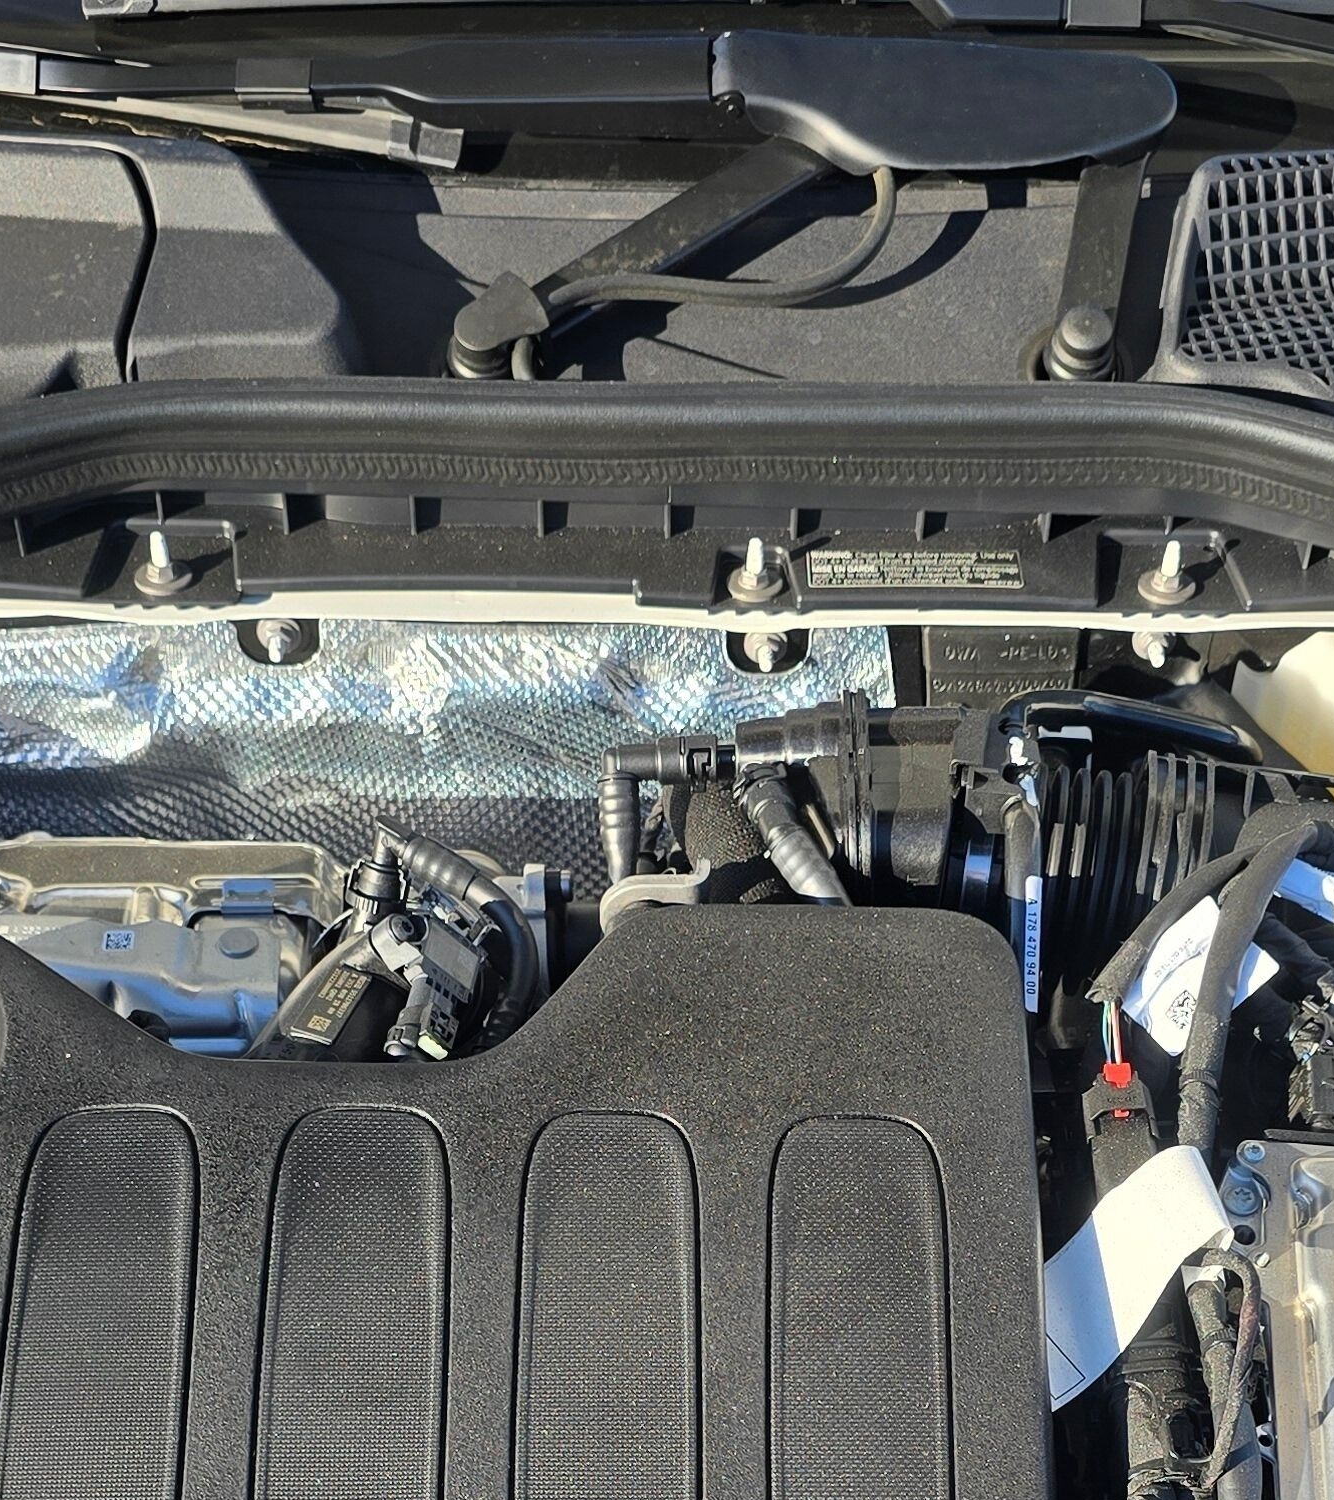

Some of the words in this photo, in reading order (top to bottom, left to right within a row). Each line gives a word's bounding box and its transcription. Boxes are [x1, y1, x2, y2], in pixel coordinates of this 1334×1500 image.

[1027, 911, 1037, 932] 178
[1026, 936, 1037, 958] 470
[1026, 964, 1036, 976] 94
[1026, 982, 1036, 995] 00
